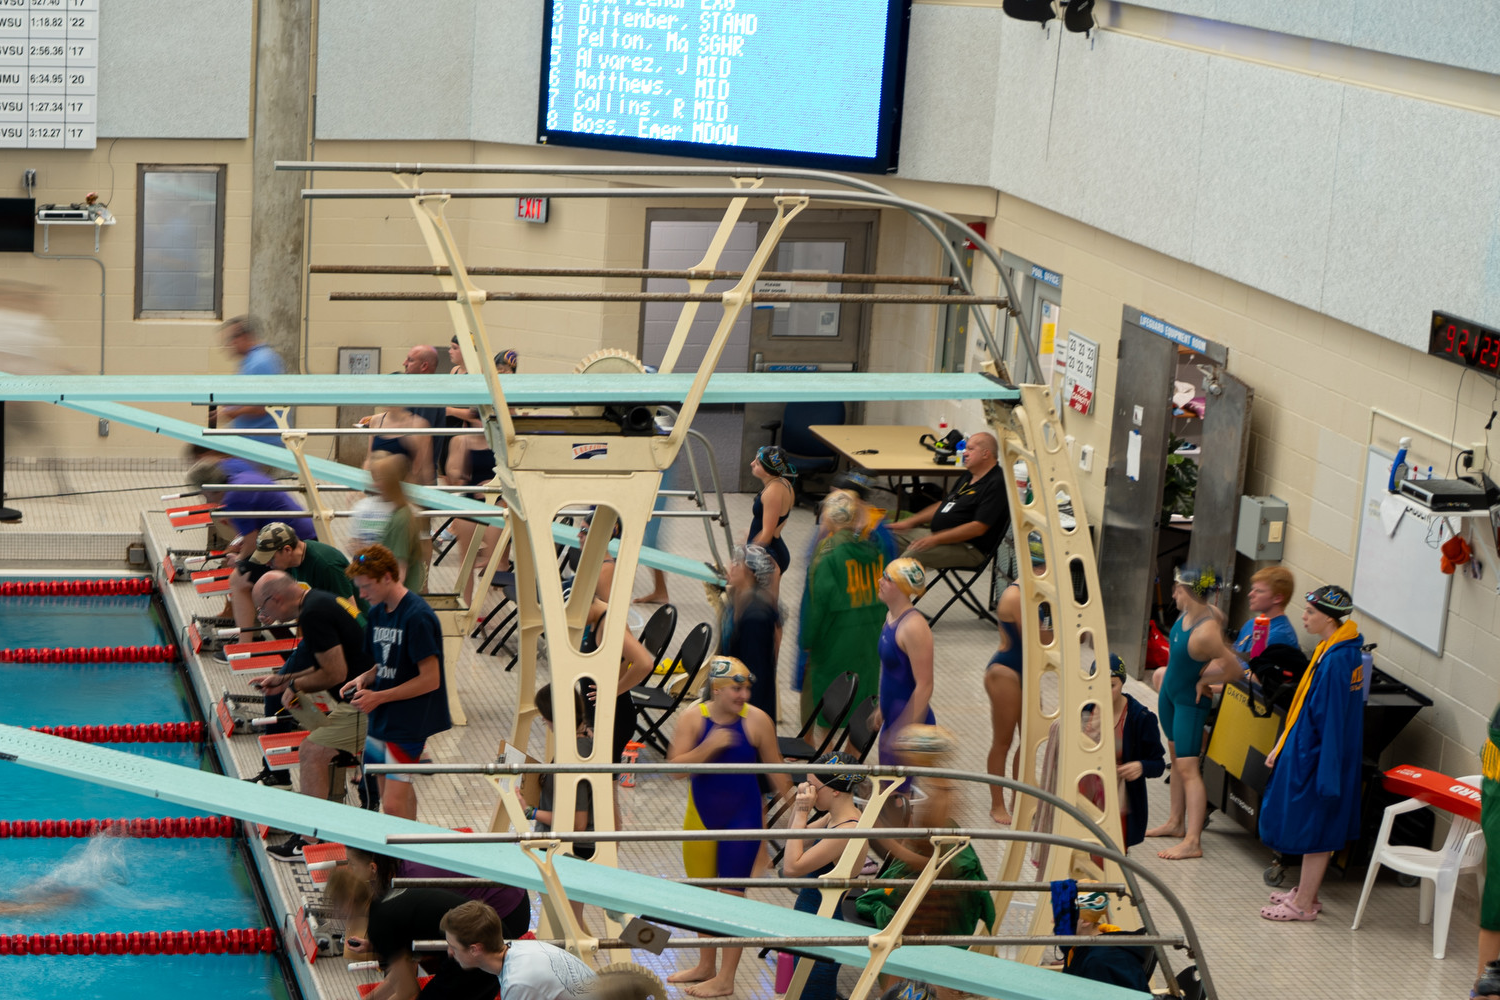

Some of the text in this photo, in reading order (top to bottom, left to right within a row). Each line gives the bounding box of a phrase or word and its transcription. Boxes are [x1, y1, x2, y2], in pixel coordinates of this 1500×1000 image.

[31, 17, 63, 27] 1:18.82
[70, 18, 85, 27] '22
[552, 24, 562, 44] 4
[577, 25, 652, 50] Pelton,
[666, 31, 689, 53] Ma
[30, 46, 63, 56] 2:56.36
[69, 46, 84, 56] '17
[551, 45, 731, 78] 5 Alvarez, J MID
[30, 74, 63, 84] 6:34.95
[69, 75, 84, 84] '20
[549, 67, 729, 100] 6 Matthews, MID
[30, 102, 63, 112] 1:27.34
[68, 103, 83, 112] '17
[548, 88, 728, 122] 7 Collins, R MID
[547, 110, 558, 130] 8
[572, 111, 625, 135] Boss,
[29, 128, 61, 138] 3:12.27
[68, 129, 83, 138] '17
[517, 197, 543, 220] EXIT
[1031, 266, 1060, 286] POOL OFFICE
[1139, 315, 1207, 352] LIFEGUARD EQUIPMENT ROOM
